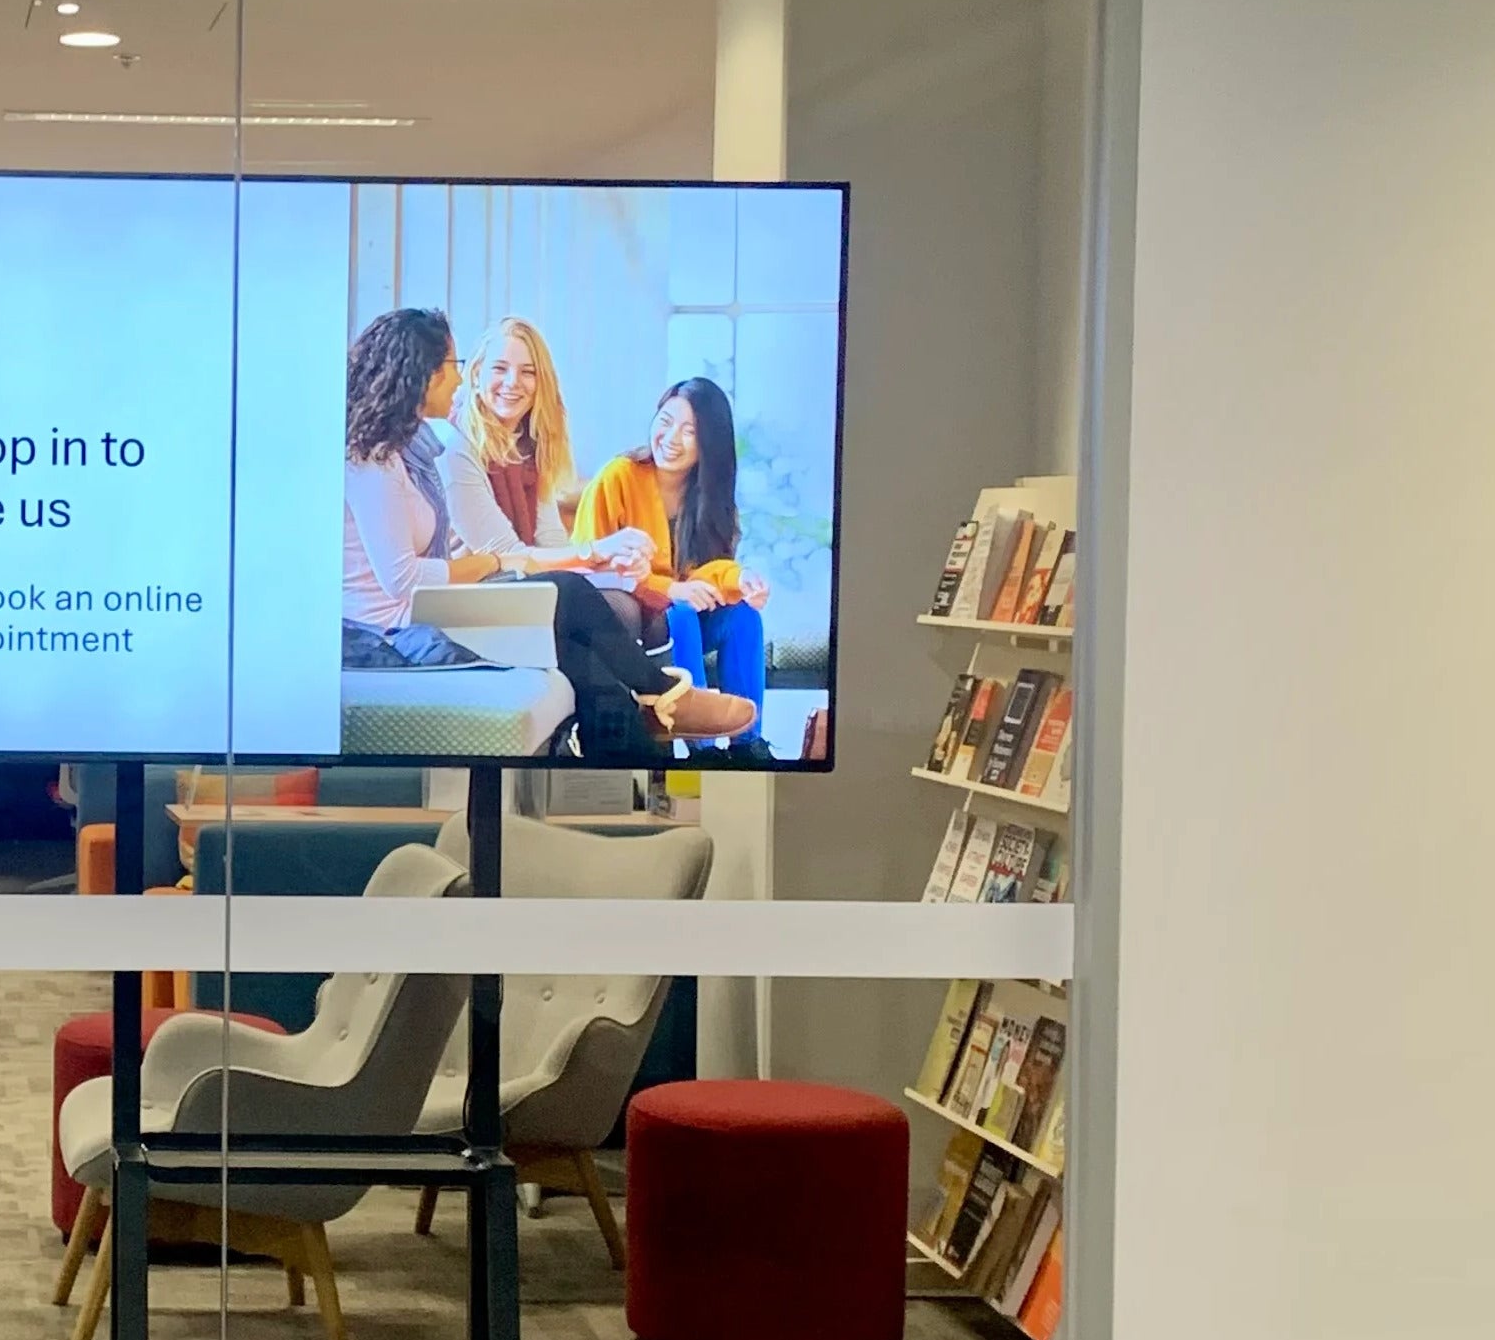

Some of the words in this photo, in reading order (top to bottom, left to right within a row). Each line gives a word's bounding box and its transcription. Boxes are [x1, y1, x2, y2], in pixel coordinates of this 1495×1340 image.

[51, 427, 88, 467] in
[100, 432, 146, 468] to
[20, 498, 72, 528] us
[55, 589, 94, 611] an
[104, 585, 203, 613] online
